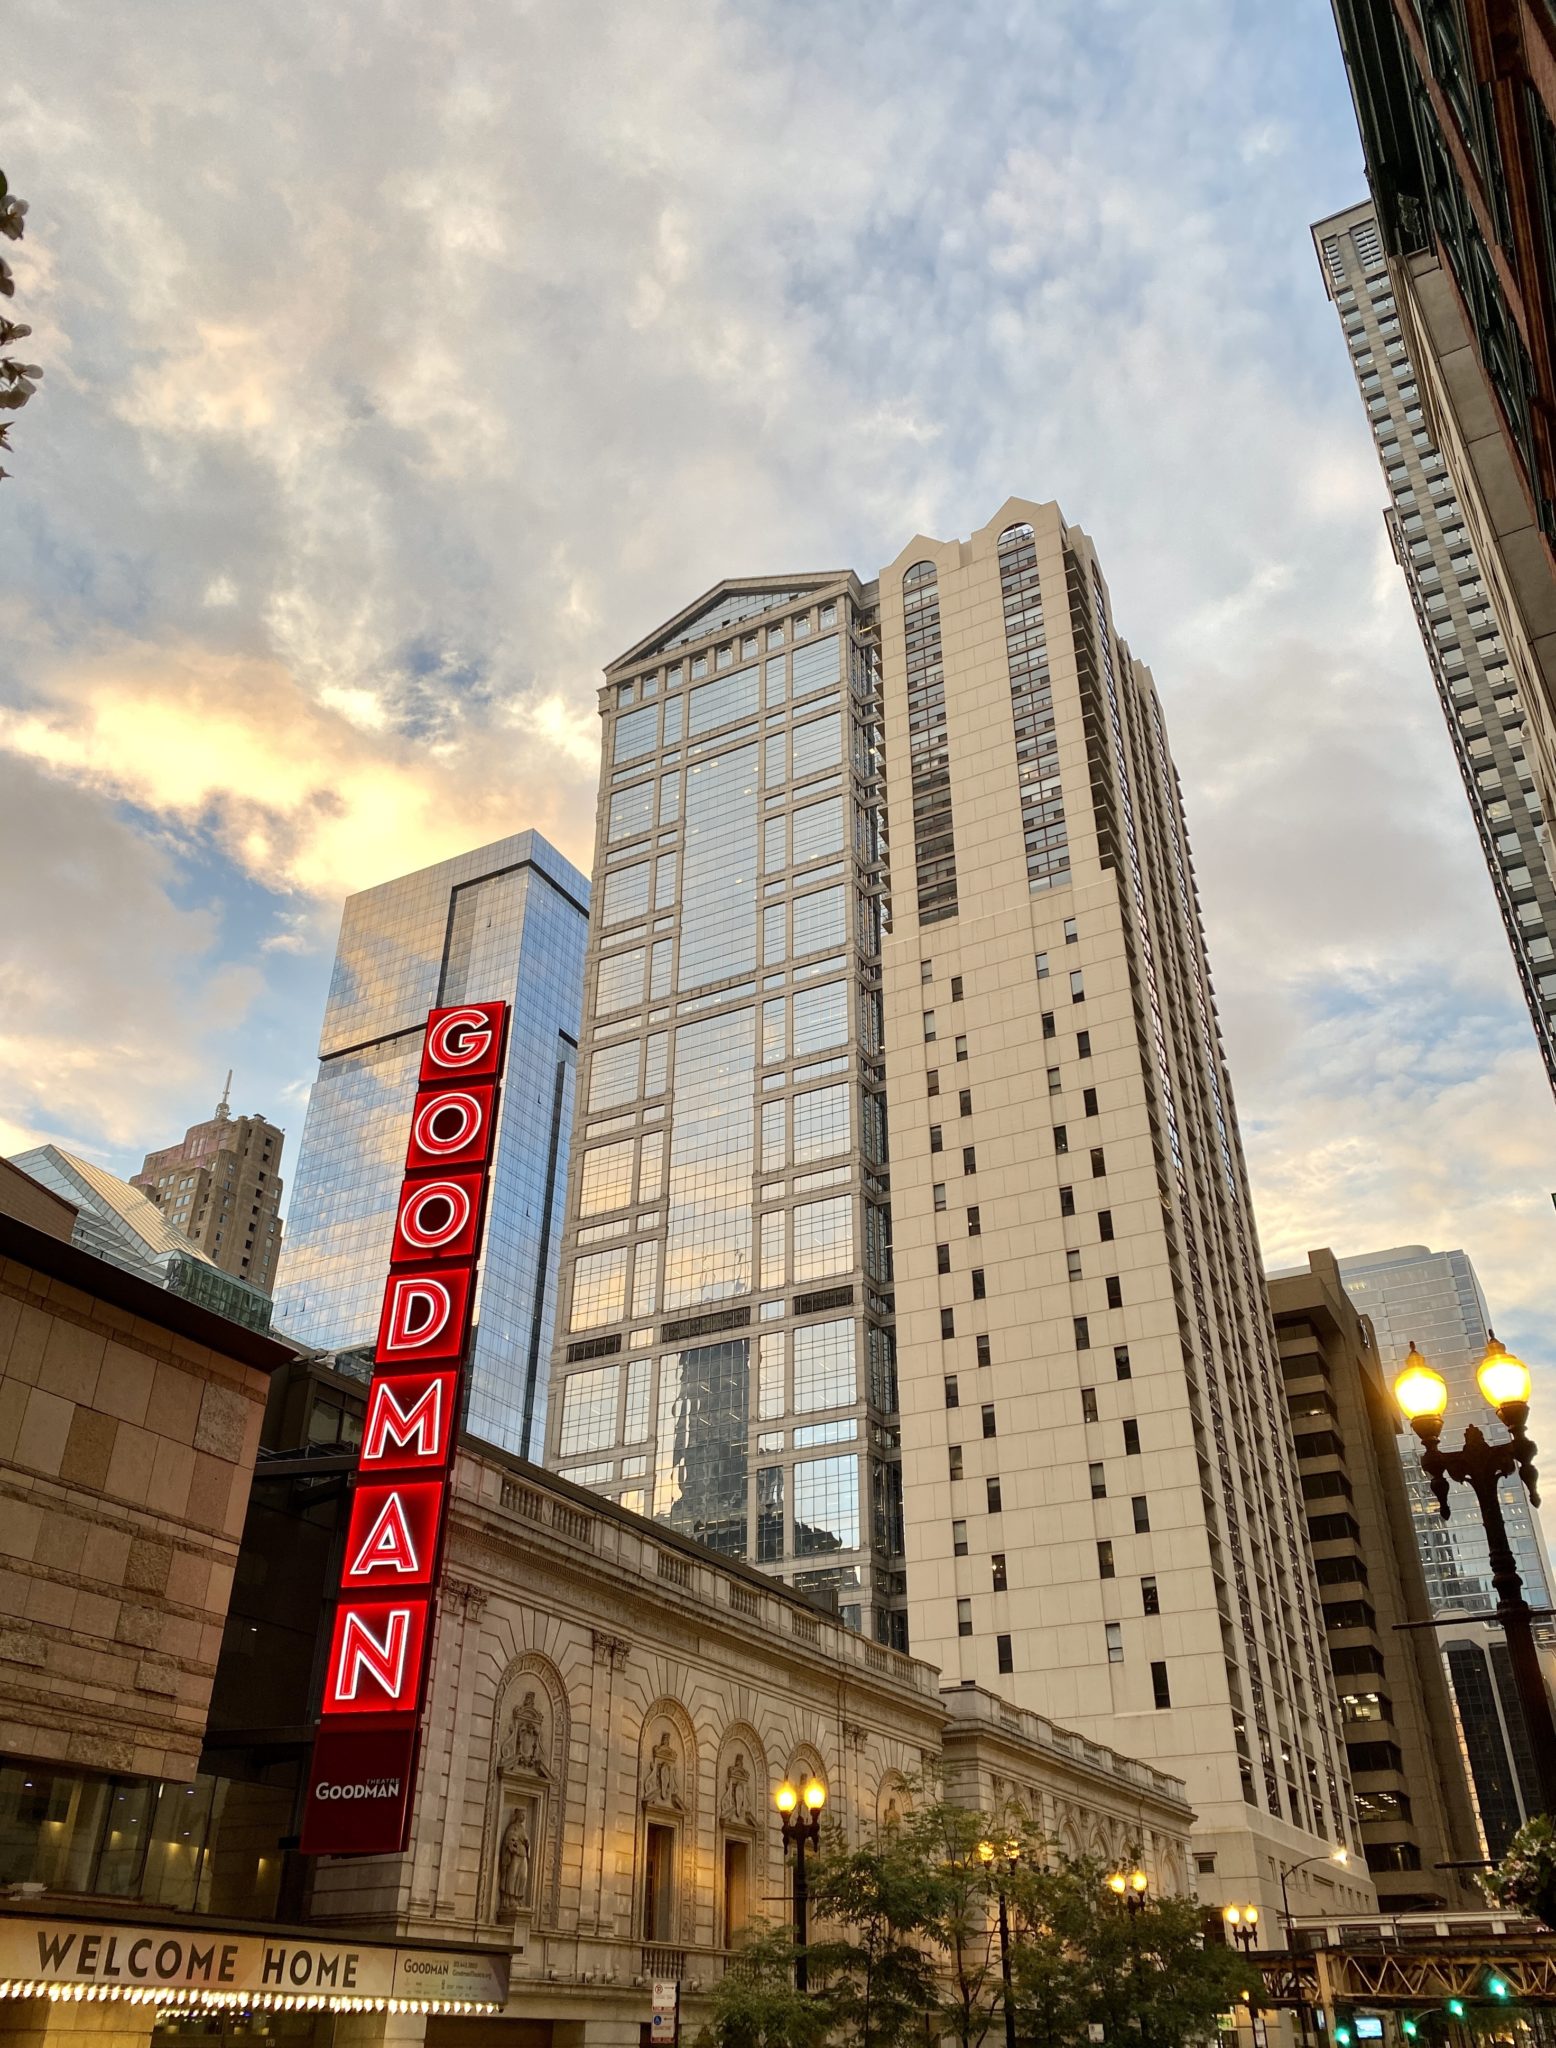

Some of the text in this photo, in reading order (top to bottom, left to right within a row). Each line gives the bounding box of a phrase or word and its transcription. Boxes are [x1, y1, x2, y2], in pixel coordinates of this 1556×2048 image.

[334, 1009, 492, 1700] GOODMAN
[315, 1782, 399, 1800] GOODMAN
[37, 1931, 359, 1988] WELCOME HOME
[404, 1959, 449, 1975] GOODMAN
